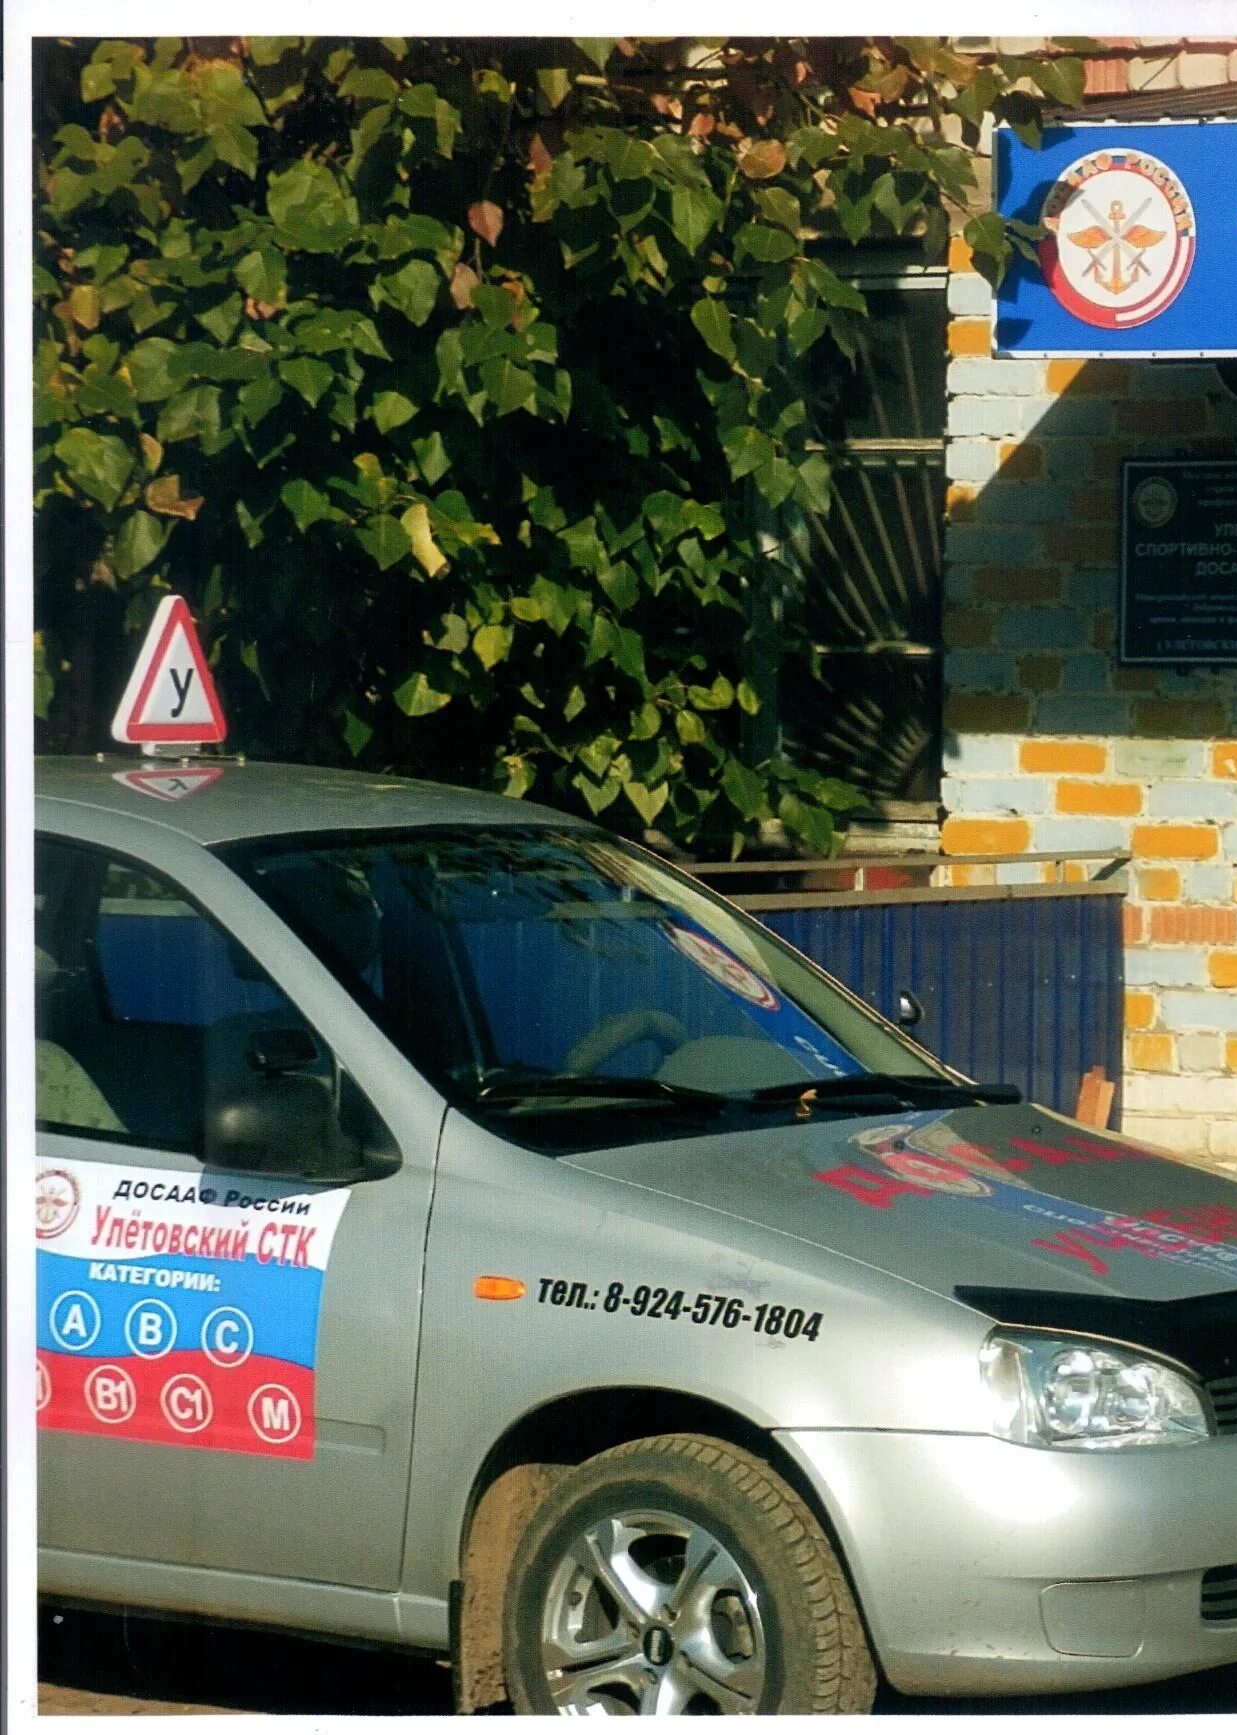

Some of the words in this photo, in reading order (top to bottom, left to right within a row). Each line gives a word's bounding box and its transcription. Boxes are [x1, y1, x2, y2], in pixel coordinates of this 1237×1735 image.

[113, 1179, 218, 1206] ДОСААФ
[90, 1204, 251, 1262] Улётовский
[256, 1221, 318, 1268] СТК
[88, 1262, 221, 1292] КАТЕГОРИИ:
[138, 1312, 164, 1346] B
[603, 1281, 824, 1342] 8-924-576-1804
[95, 1376, 129, 1413] B1
[170, 1386, 202, 1421] C1
[261, 1396, 291, 1432] M
